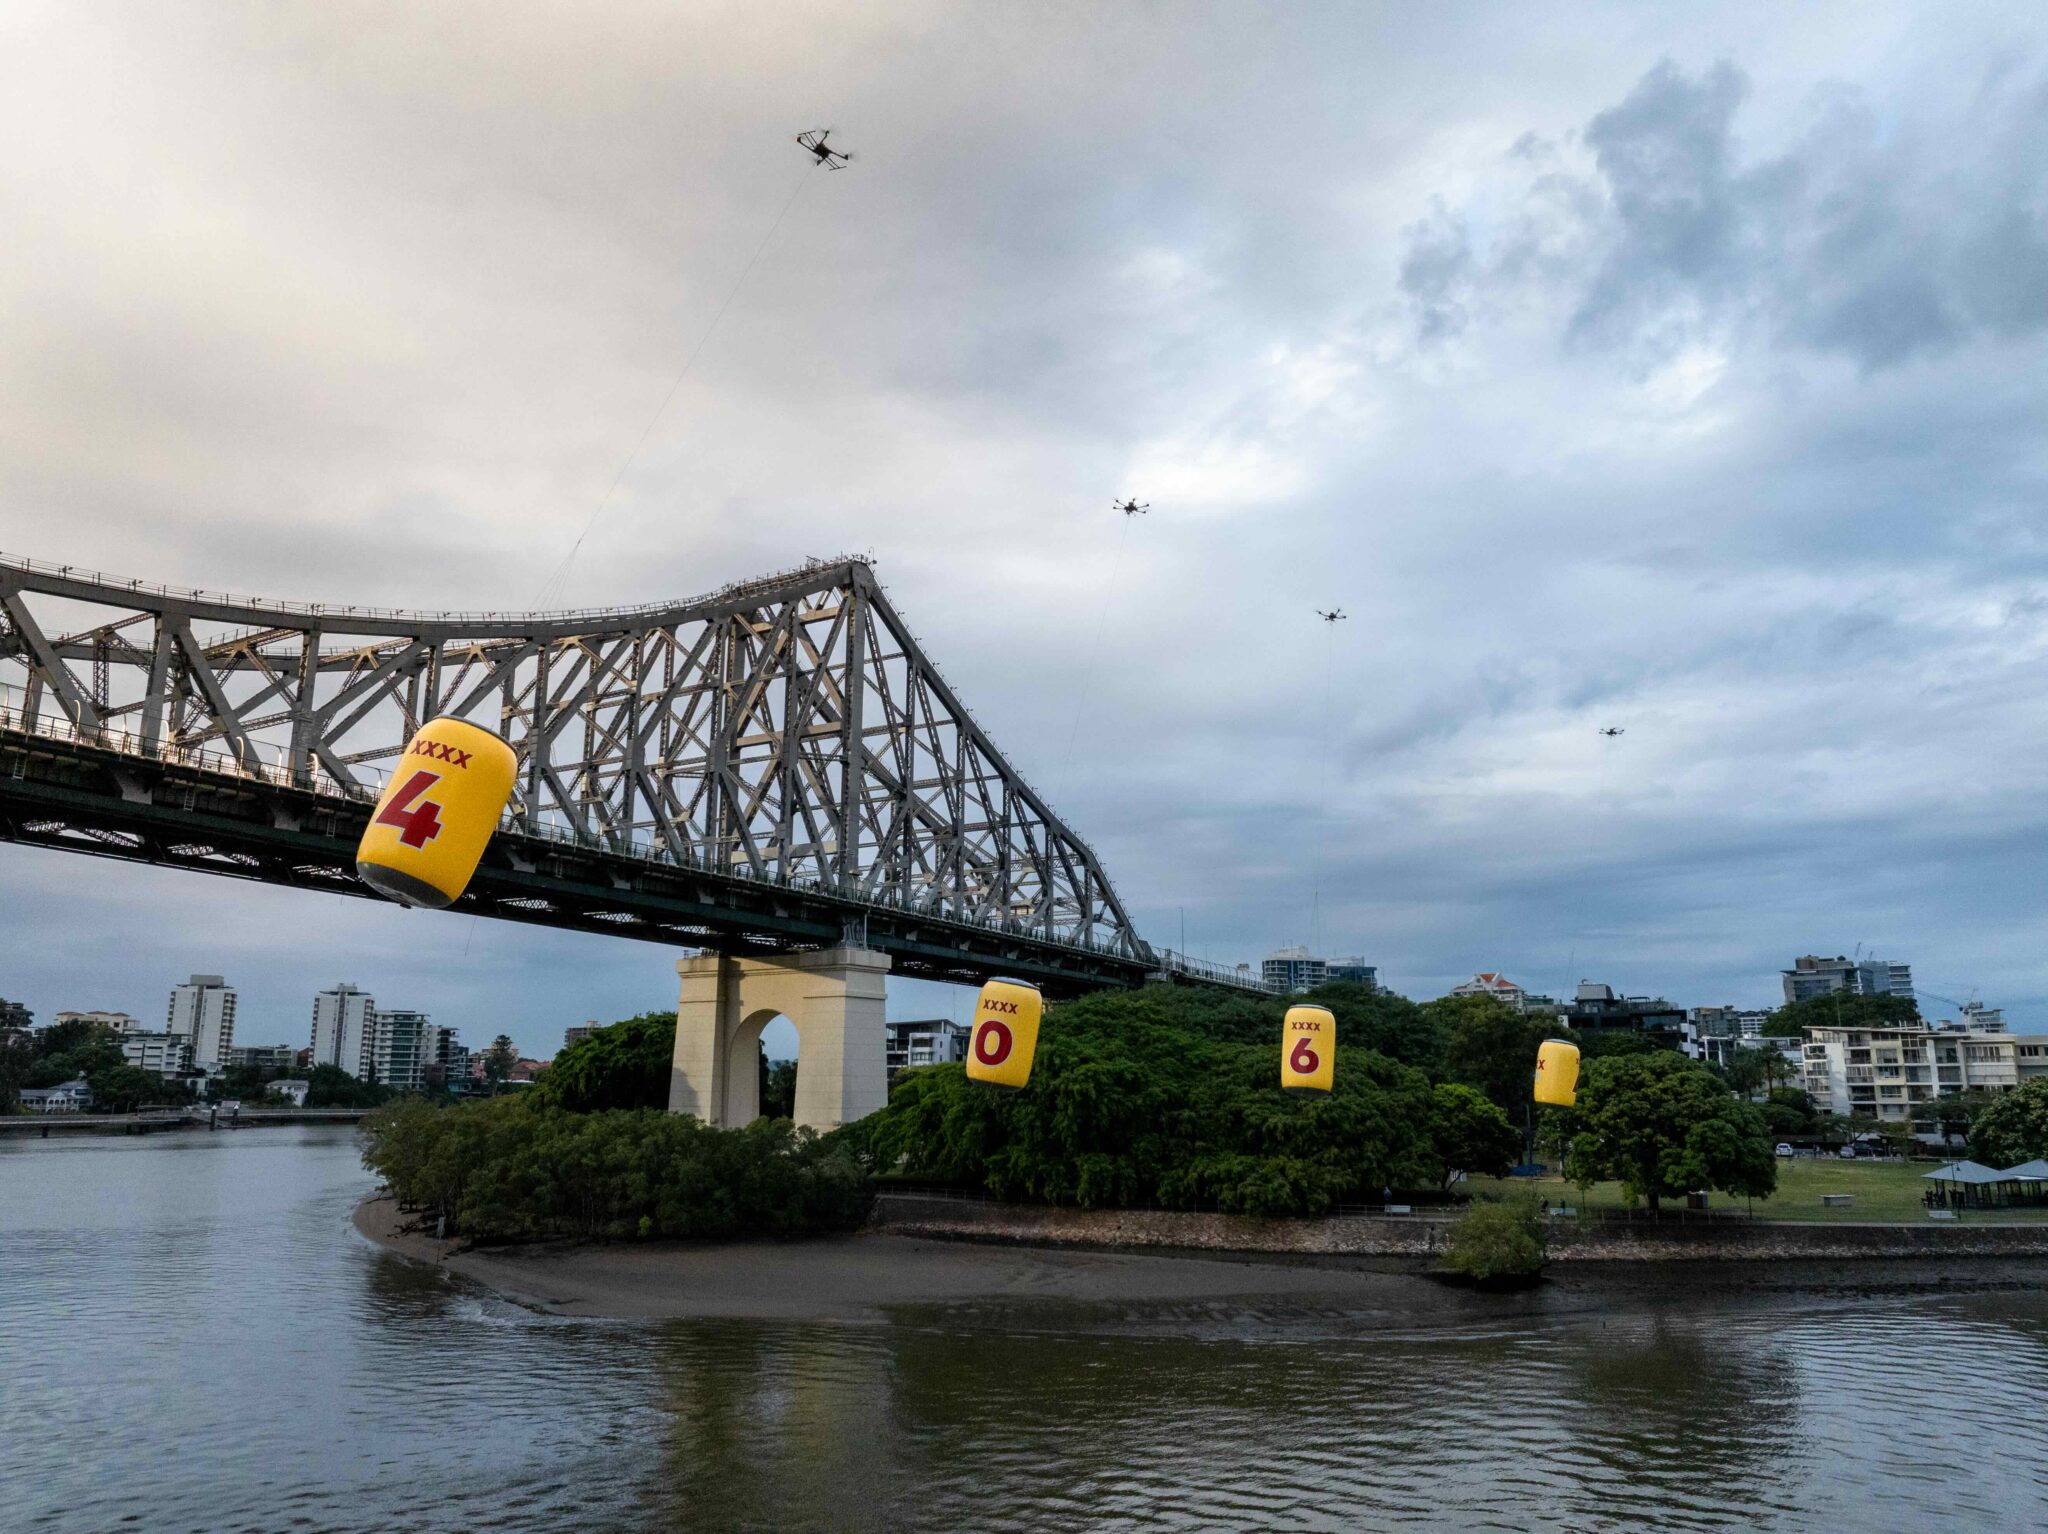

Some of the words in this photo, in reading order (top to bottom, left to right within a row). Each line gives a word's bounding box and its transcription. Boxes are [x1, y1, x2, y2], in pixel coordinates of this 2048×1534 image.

[410, 740, 473, 769] XXXX
[375, 770, 442, 849] 4
[983, 998, 1018, 1015] XXXX
[1291, 1021, 1321, 1032] XXXX
[1290, 1037, 1320, 1074] 6
